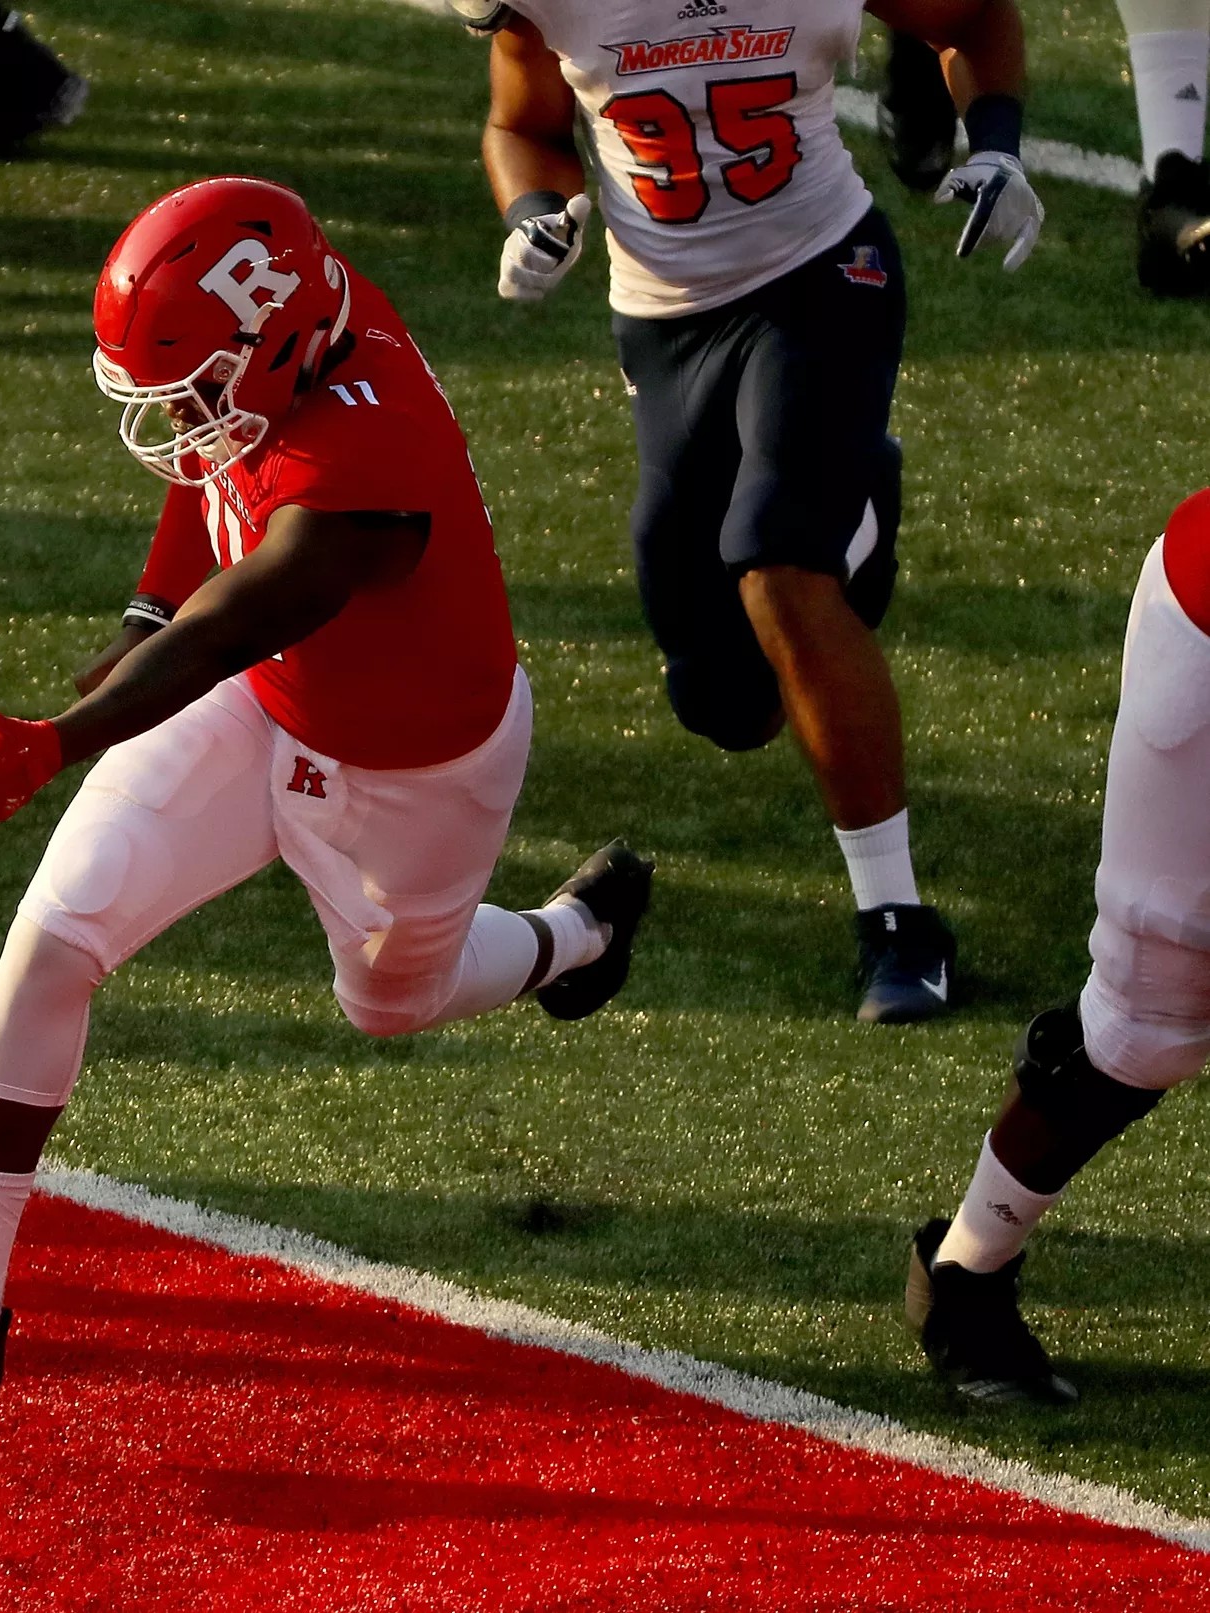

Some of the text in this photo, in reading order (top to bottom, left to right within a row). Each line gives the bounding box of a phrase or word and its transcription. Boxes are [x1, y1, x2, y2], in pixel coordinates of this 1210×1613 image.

[677, 5, 728, 19] adidas
[599, 71, 802, 224] 95
[197, 239, 301, 334] R
[329, 381, 380, 405] 11
[286, 755, 328, 799] R
